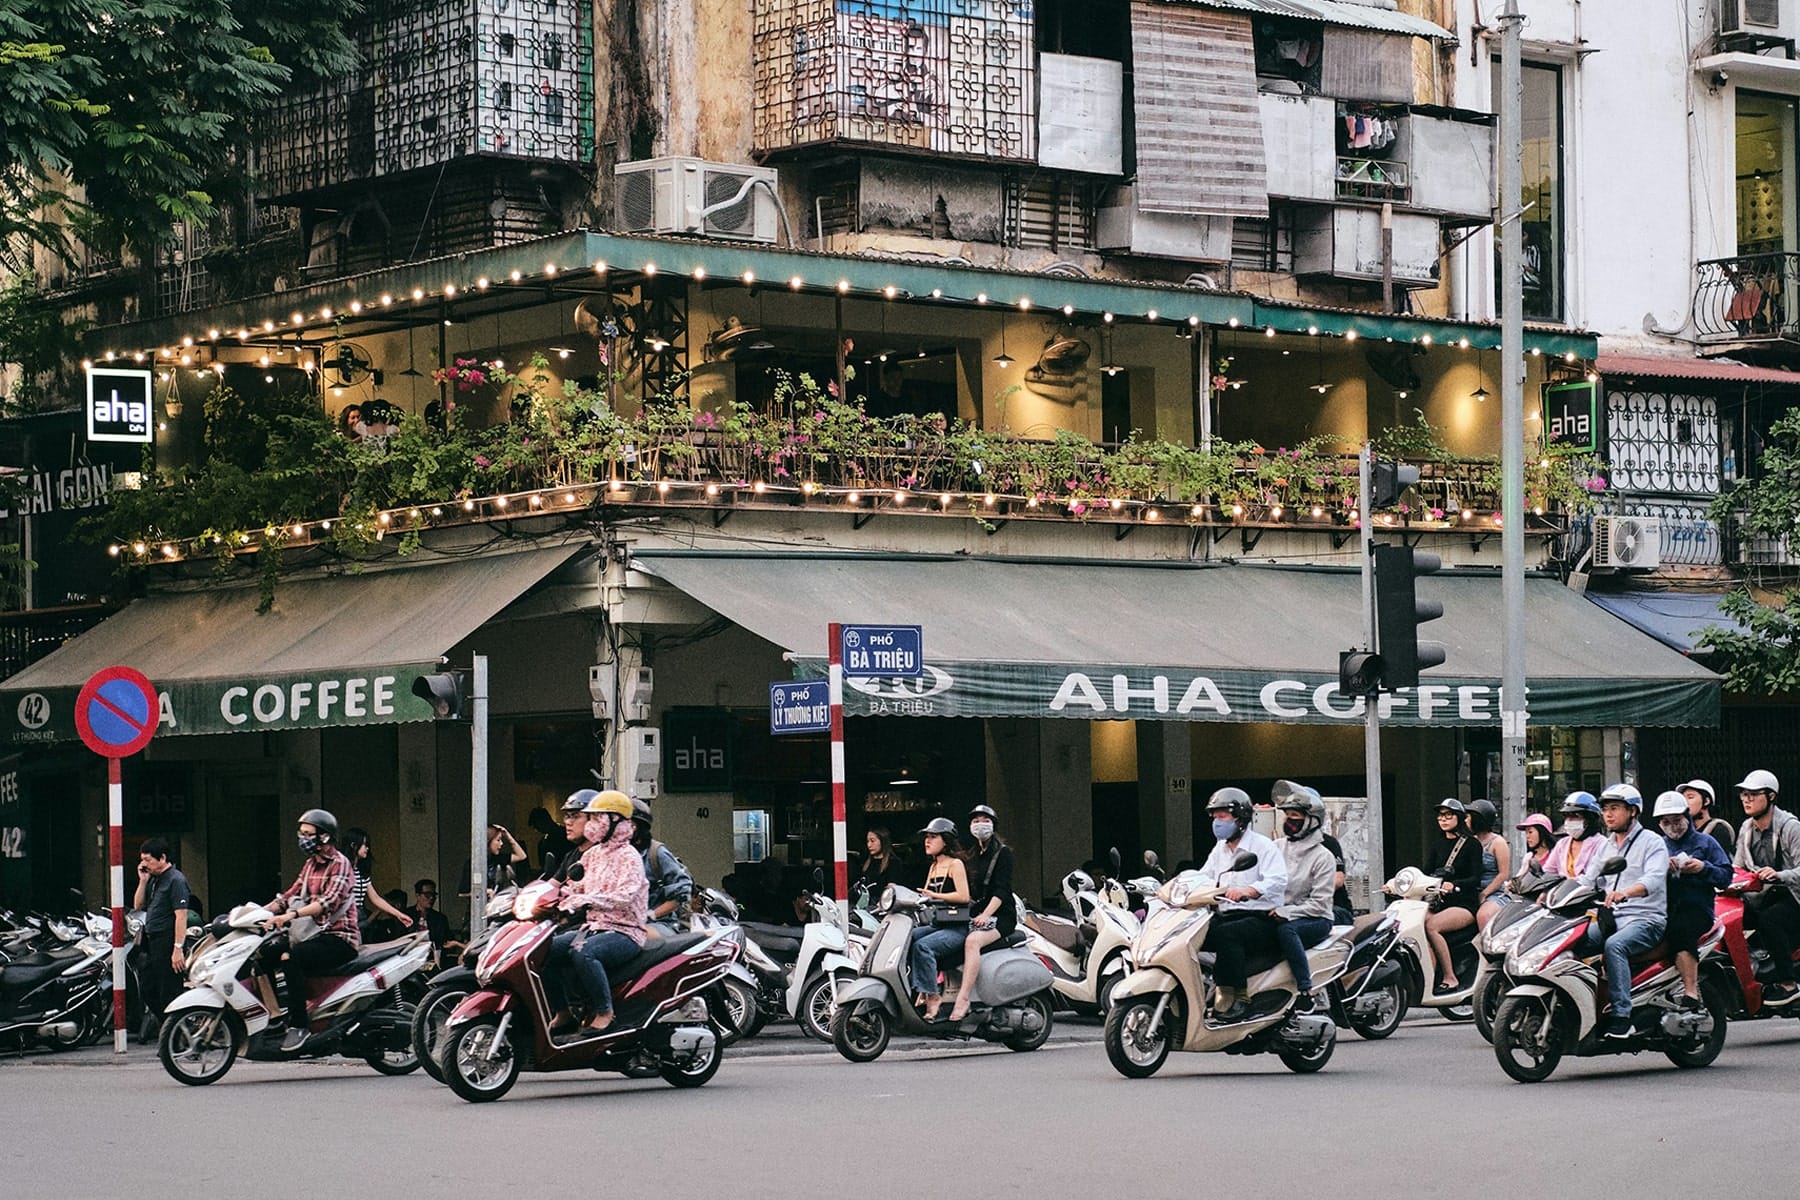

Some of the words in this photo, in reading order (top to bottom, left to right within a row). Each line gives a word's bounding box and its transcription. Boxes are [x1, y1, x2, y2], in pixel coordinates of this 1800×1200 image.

[94, 389, 145, 423] aha
[1551, 404, 1590, 436] aha
[870, 632, 894, 646] PHỐ
[850, 646, 870, 669] BÀ
[873, 647, 914, 672] TRIỆU
[220, 676, 395, 725] COFFEE
[791, 685, 810, 701] PHỐ
[1049, 672, 1232, 715] AHA
[25, 696, 43, 725] 42
[775, 703, 783, 726] LÝ
[784, 702, 812, 725] THƯỜNG
[812, 701, 828, 726] KIỆT
[675, 736, 724, 769] aha
[696, 807, 710, 819] 40
[1, 826, 25, 858] 42
